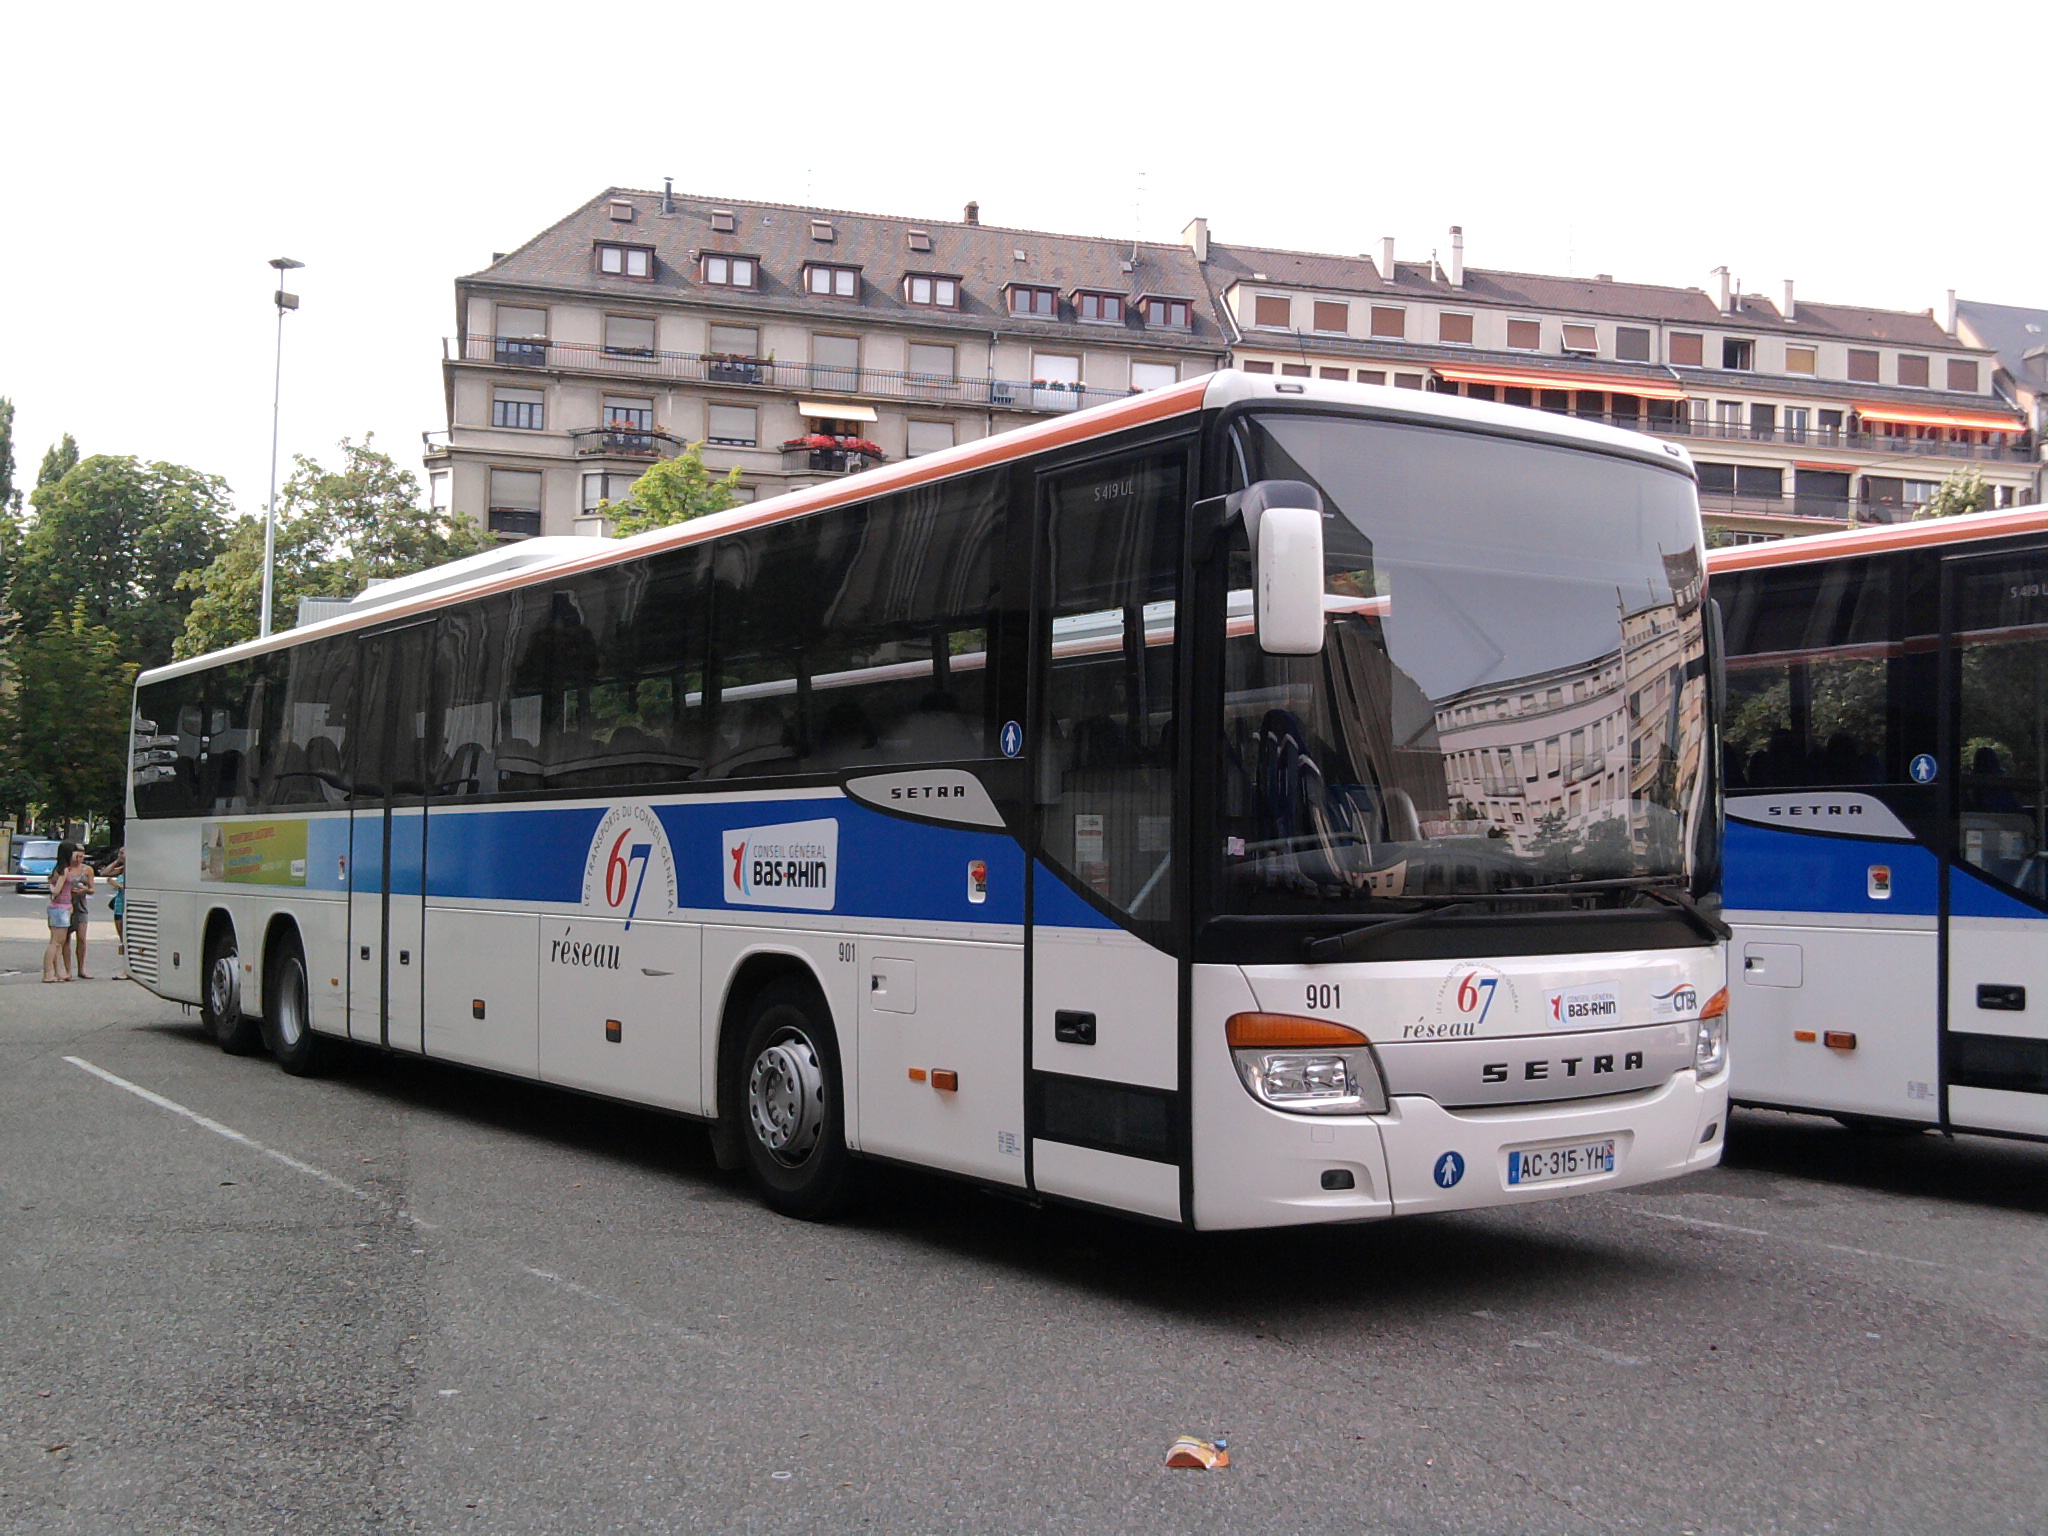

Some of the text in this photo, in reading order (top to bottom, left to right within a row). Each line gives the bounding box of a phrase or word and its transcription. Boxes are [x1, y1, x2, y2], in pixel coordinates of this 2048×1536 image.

[1094, 480, 1135, 502] S 419 UL
[890, 785, 965, 799] SETRA
[1768, 804, 1863, 817] SETRA
[587, 809, 621, 877] TRANSPORTS
[622, 805, 632, 818] DU
[634, 806, 662, 845] CONSEIL
[753, 842, 827, 859] CONSEIL GÉNÉRAL
[606, 827, 653, 931] 67
[551, 926, 621, 970] réseau
[839, 942, 856, 963] 901
[1306, 984, 1341, 1010] 901
[1457, 971, 1498, 1025] 67
[1567, 994, 1590, 1003] CONSEIL
[1673, 990, 1698, 1012] CTBR
[1402, 1015, 1476, 1039] réseau
[1482, 1051, 1643, 1084] SETRA
[1521, 1146, 1605, 1179] AC-315-YH
